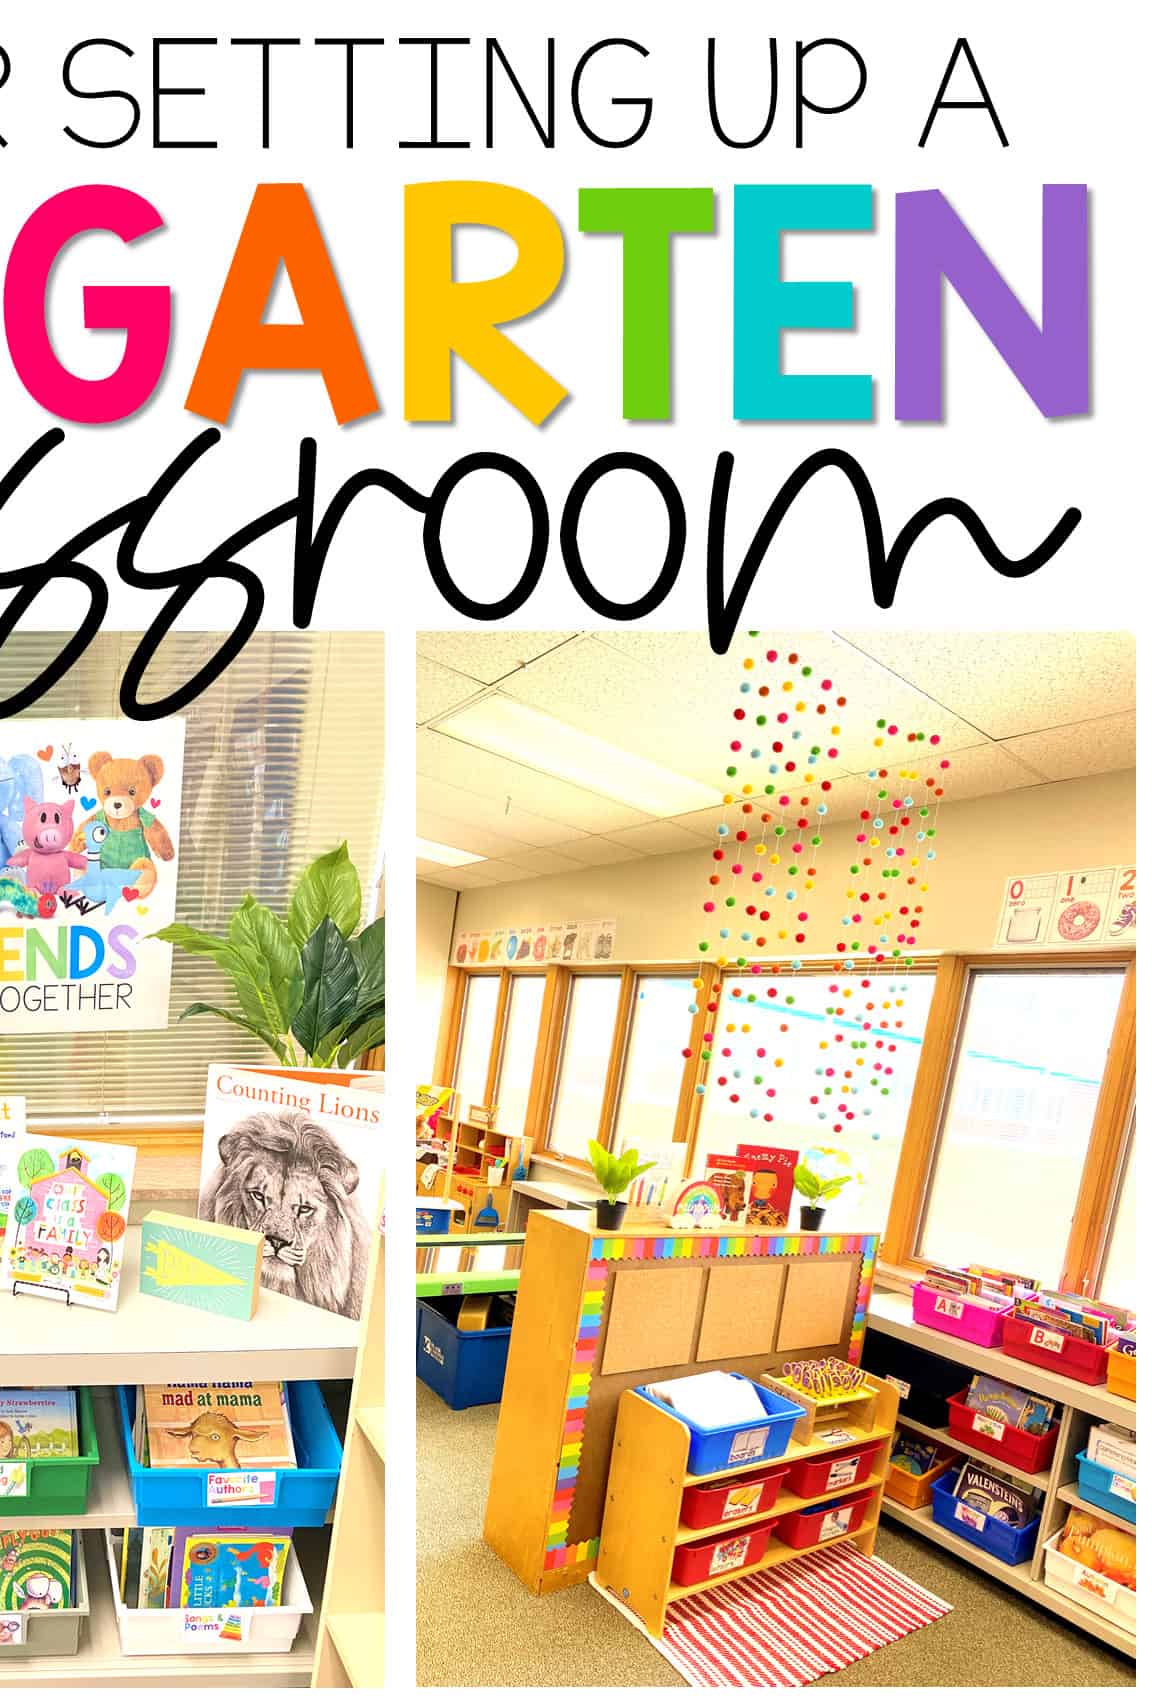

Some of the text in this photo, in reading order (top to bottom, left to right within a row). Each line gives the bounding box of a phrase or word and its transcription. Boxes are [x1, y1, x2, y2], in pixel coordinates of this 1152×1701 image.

[1119, 870, 1136, 891] 2
[1010, 880, 1024, 900] 0
[216, 1074, 382, 1124] Counting Lions
[936, 1296, 947, 1311] A
[1034, 1330, 1045, 1344] B
[162, 1391, 262, 1406] mad at mama
[730, 1449, 755, 1461] boards
[208, 1474, 259, 1485] Favorite
[208, 1484, 255, 1495] Authors
[967, 1472, 1026, 1513] VALENSTEINS
[184, 1614, 214, 1624] Songs
[184, 1623, 219, 1632] Poems
